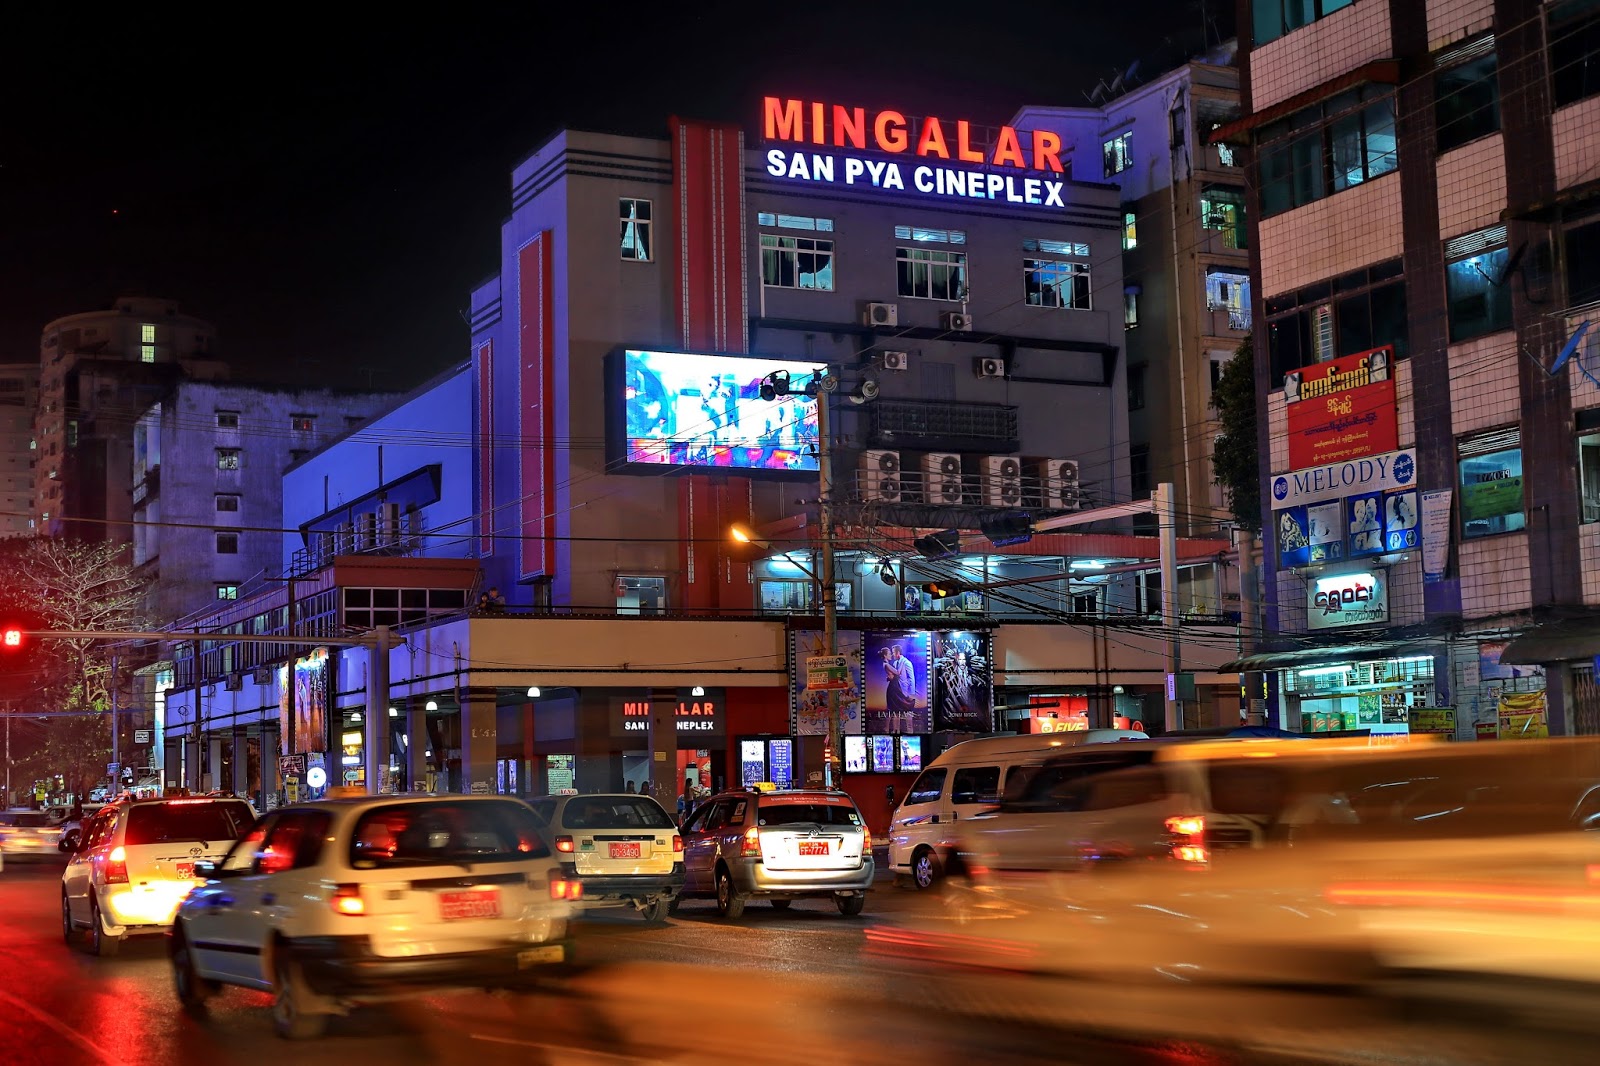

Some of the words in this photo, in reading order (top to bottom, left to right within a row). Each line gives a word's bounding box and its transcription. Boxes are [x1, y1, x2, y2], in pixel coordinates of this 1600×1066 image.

[764, 96, 1064, 173] MINGALAR
[766, 149, 835, 182] SAN
[845, 157, 905, 190] PYA
[914, 166, 1065, 208] CINEPLEX
[1293, 455, 1390, 497] MELODY
[624, 721, 645, 730] SAN
[676, 721, 714, 730] NEPLEX
[1055, 722, 1085, 732] FIVE
